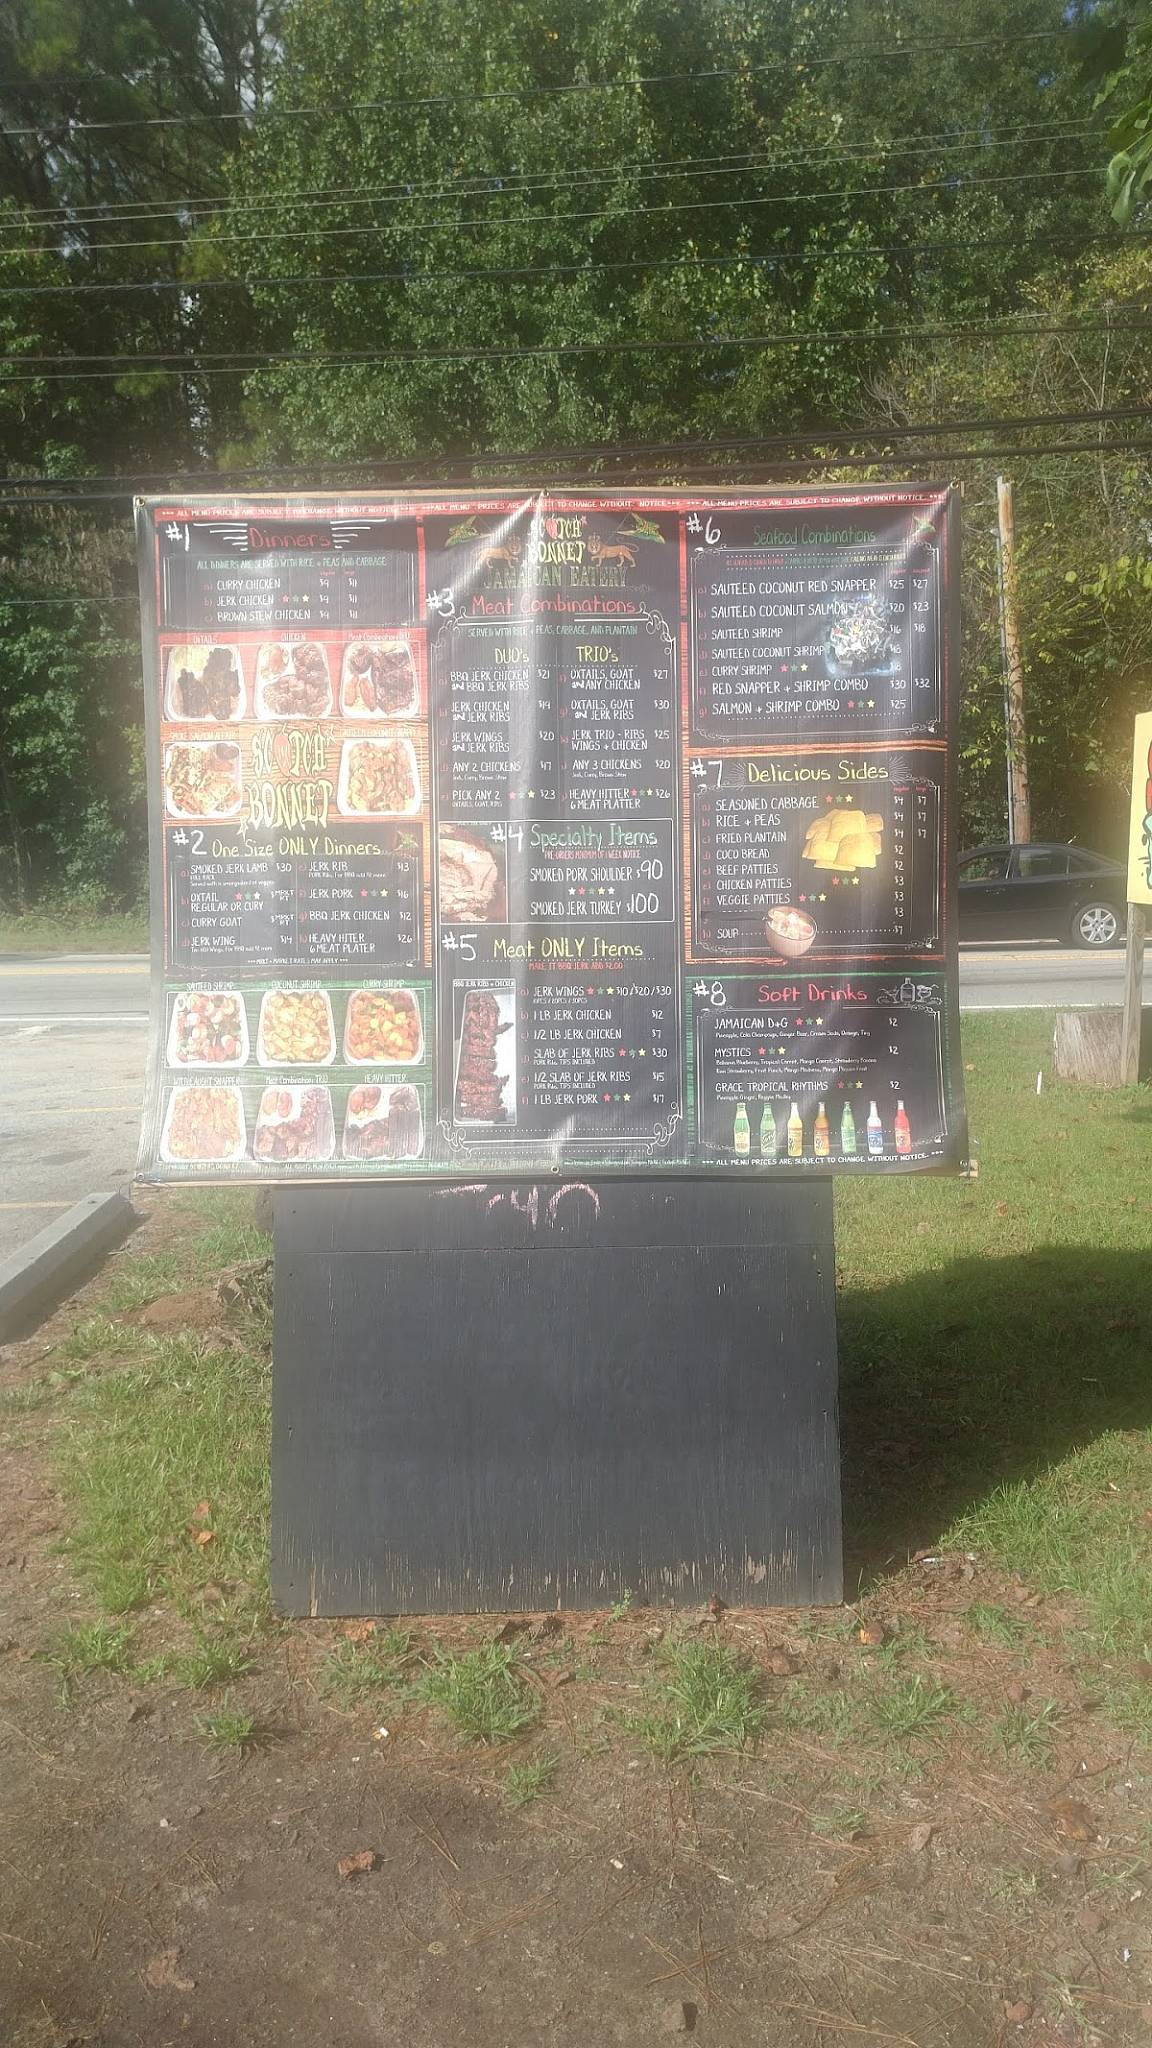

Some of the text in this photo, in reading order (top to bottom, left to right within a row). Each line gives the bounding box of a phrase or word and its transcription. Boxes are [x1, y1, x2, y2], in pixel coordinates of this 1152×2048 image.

[250, 527, 331, 548] Dinners
[754, 525, 875, 545] Seafood Combinations
[571, 567, 627, 587] EATERY
[217, 578, 281, 590] CURRY CHICKEN
[712, 579, 928, 595] SAUTEED COCONUT RED SNAPPER $25 $27
[239, 595, 274, 605] CHICKEN
[472, 595, 636, 615] Meat Combinations
[712, 602, 929, 618] SAUTEED COCONUT SALMON $20 $23
[217, 610, 311, 622] BROWN CHICKEN
[712, 623, 926, 640] SAUTEED SHRIMP $18
[712, 645, 824, 659] SAUTEED COCONUT SHRIMP
[471, 670, 529, 681] JERK CHICKEN
[610, 669, 633, 679] GOAT
[712, 665, 772, 676] CURRY SHRIMP
[487, 681, 507, 691] JERK
[605, 679, 640, 689] CHICKEN
[712, 679, 930, 695] RED SNAPPER SHRIMP COMBO $30 $32
[451, 702, 509, 712] JERK CHICKEN
[611, 700, 634, 709] GOAT
[712, 700, 906, 715] SALMON SHRIMP COMBO $25
[467, 713, 488, 722] JERK
[591, 710, 634, 720] JERK RIBS
[452, 732, 503, 743] JERK WINGS
[572, 730, 645, 740] JERK TRIO RIBS
[467, 743, 487, 752] JERK
[571, 740, 647, 750] WINGS CHICKEN
[481, 761, 521, 771] CHICKENS
[601, 759, 641, 769] CHICKENS
[748, 760, 888, 783] Delicious Sides
[453, 790, 473, 800] PICK
[570, 789, 629, 800] HEAVY HITTER
[246, 780, 333, 831] BONNET
[577, 799, 640, 809] MEAT PLATTER
[715, 796, 819, 811] SEASONED CABBAGE
[716, 814, 781, 827] RICE PEAS
[530, 824, 657, 852] Specialty Items
[716, 831, 786, 843] FRIED PLANTAIN
[213, 837, 381, 858] One Size ONLY Dinners
[716, 849, 770, 859] COCO BREAD
[190, 864, 222, 874] SMOKED
[530, 860, 663, 882] SMOKED PORK SHOULDER $90
[716, 864, 778, 875] BEEF PATTIES
[717, 878, 792, 889] CHICKEN PATTIES
[531, 894, 659, 915] SMOKED JERK TURKEY $100
[717, 894, 790, 905] VEGGIE PATTIES
[191, 902, 228, 912] REGULAR
[353, 911, 390, 920] CHICKEN
[309, 934, 336, 944] HEAVY
[717, 929, 739, 939] SOUP
[342, 944, 375, 953] PLATER
[494, 938, 643, 958] Meat ONLY Items
[534, 987, 584, 996] JERK WINGS
[758, 984, 868, 1002] Soft Drinks
[554, 1010, 611, 1020] JERK CHICKEN
[715, 1018, 764, 1029] JAMAICAN
[563, 1029, 622, 1039] JERK CHICKEN
[534, 1048, 614, 1059] SLAB JERK RIBS
[715, 1048, 751, 1057] MYSTICS
[549, 1072, 630, 1082] SLAB JERK RIBS
[715, 1081, 828, 1092] GRACE TROPICAL RHYTHMS
[554, 1094, 597, 1104] JERK PORK
